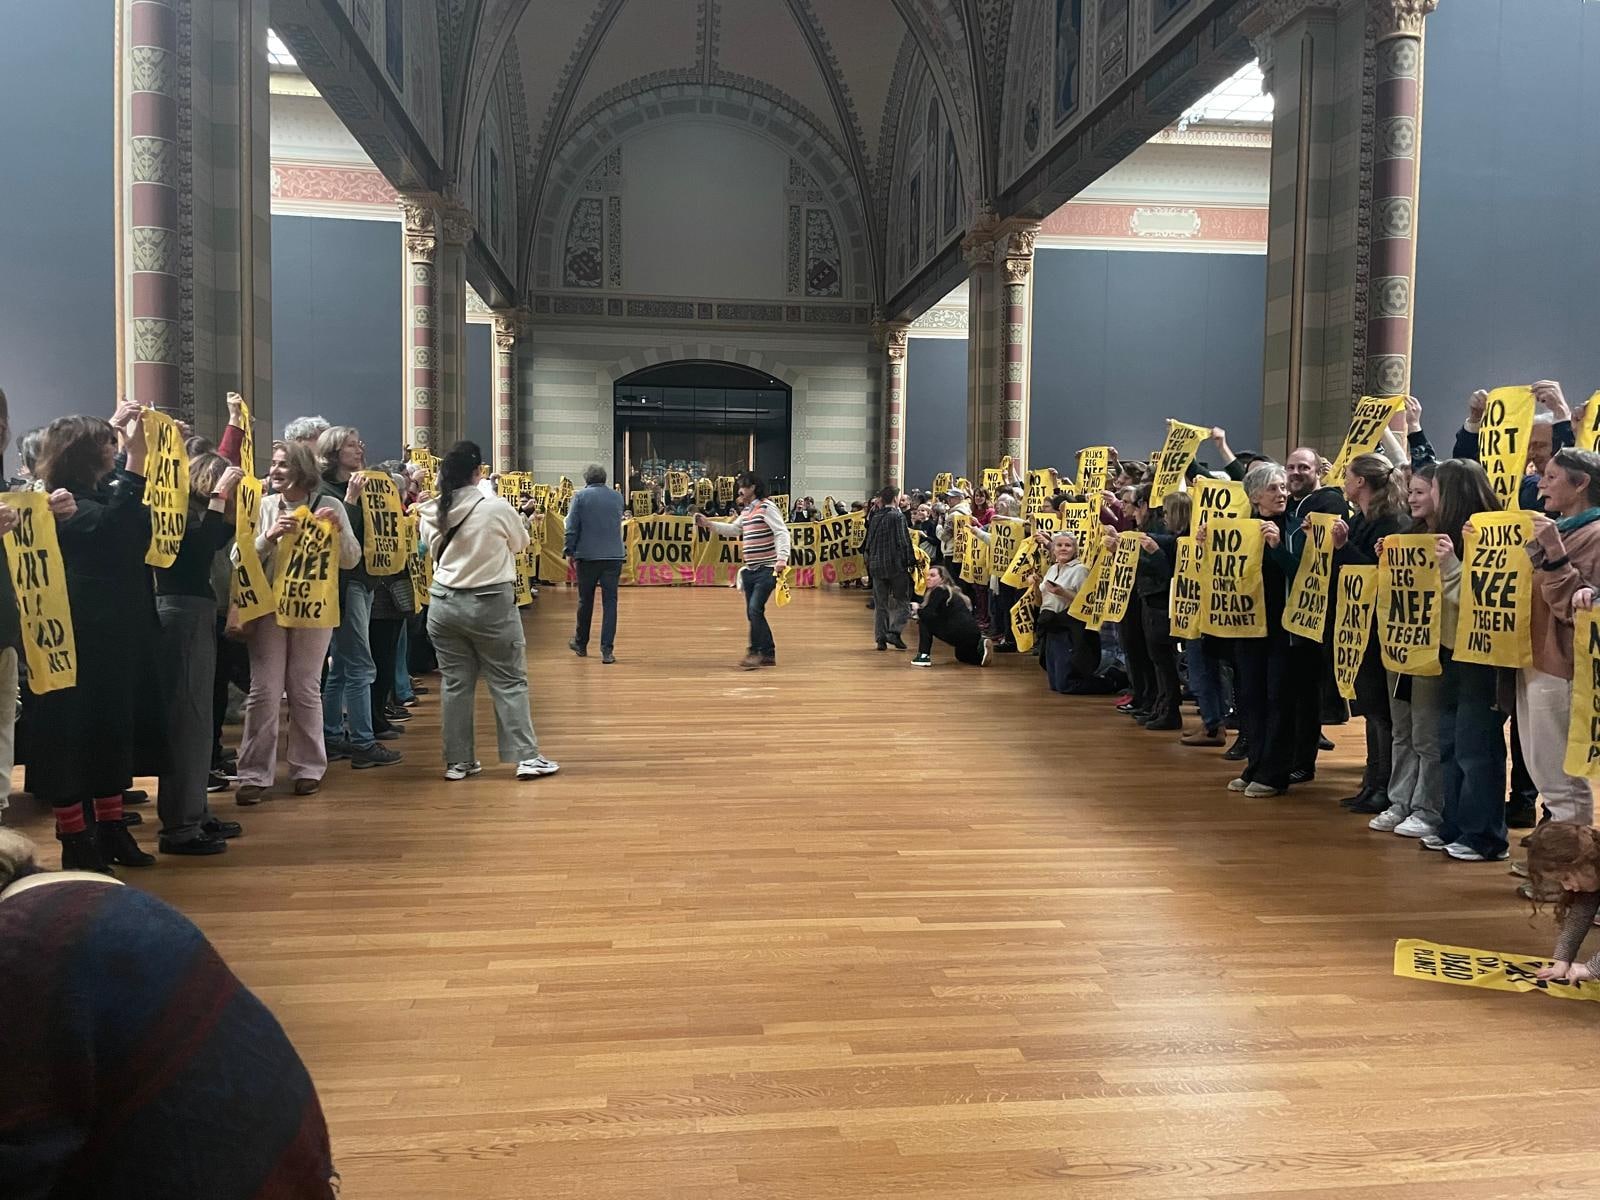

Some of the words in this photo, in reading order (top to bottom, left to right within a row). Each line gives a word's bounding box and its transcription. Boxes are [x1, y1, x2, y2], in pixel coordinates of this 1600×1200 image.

[157, 422, 173, 455] NO
[1166, 439, 1185, 453] ZEG
[1084, 450, 1105, 460] RIJKS,
[1084, 458, 1097, 467] ZEG
[1159, 452, 1191, 473] NEE
[155, 456, 181, 491] ART
[987, 472, 999, 482] NO
[1493, 459, 1505, 474] A
[1029, 473, 1042, 486] NO
[366, 495, 386, 510] ZEG
[1028, 486, 1047, 498] ART
[1199, 486, 1232, 510] NO
[1026, 505, 1043, 514] DEA
[153, 511, 184, 537] DEAD
[370, 511, 399, 538] NEE
[638, 521, 712, 544] WILLEN
[995, 524, 1012, 538] NO
[1036, 517, 1054, 530] NO
[1065, 518, 1080, 528] ZEG
[374, 538, 400, 554] TEGEN
[995, 537, 1016, 551] ART
[1211, 528, 1243, 553] NO
[1312, 523, 1326, 551] NO
[1478, 523, 1530, 548] RIJKS,
[372, 553, 392, 569] ING
[637, 542, 693, 563] VOOR
[993, 555, 1013, 564] DEA
[1116, 550, 1129, 565] ZEG
[1387, 547, 1435, 570] RIJKS,
[1471, 547, 1508, 569] ZEG
[1212, 554, 1249, 579] ART
[1212, 578, 1227, 592] ON
[1228, 579, 1238, 593] A
[1343, 574, 1364, 603] NO
[1390, 568, 1415, 589] ZEG
[1470, 570, 1519, 610] NEE
[1210, 592, 1255, 614] DEAD
[1388, 589, 1436, 626] NEE
[1209, 612, 1256, 628] PLANET
[1340, 602, 1370, 630] ART
[1472, 610, 1517, 633] TEGEN
[1338, 629, 1354, 645] ON
[1355, 629, 1363, 645] A
[1386, 623, 1431, 646] TEGEN
[1467, 631, 1492, 655] ING
[1337, 646, 1360, 668] DEA
[1384, 644, 1409, 665] ING
[1413, 948, 1438, 976] PLANET
[1440, 952, 1475, 981] DEAD
